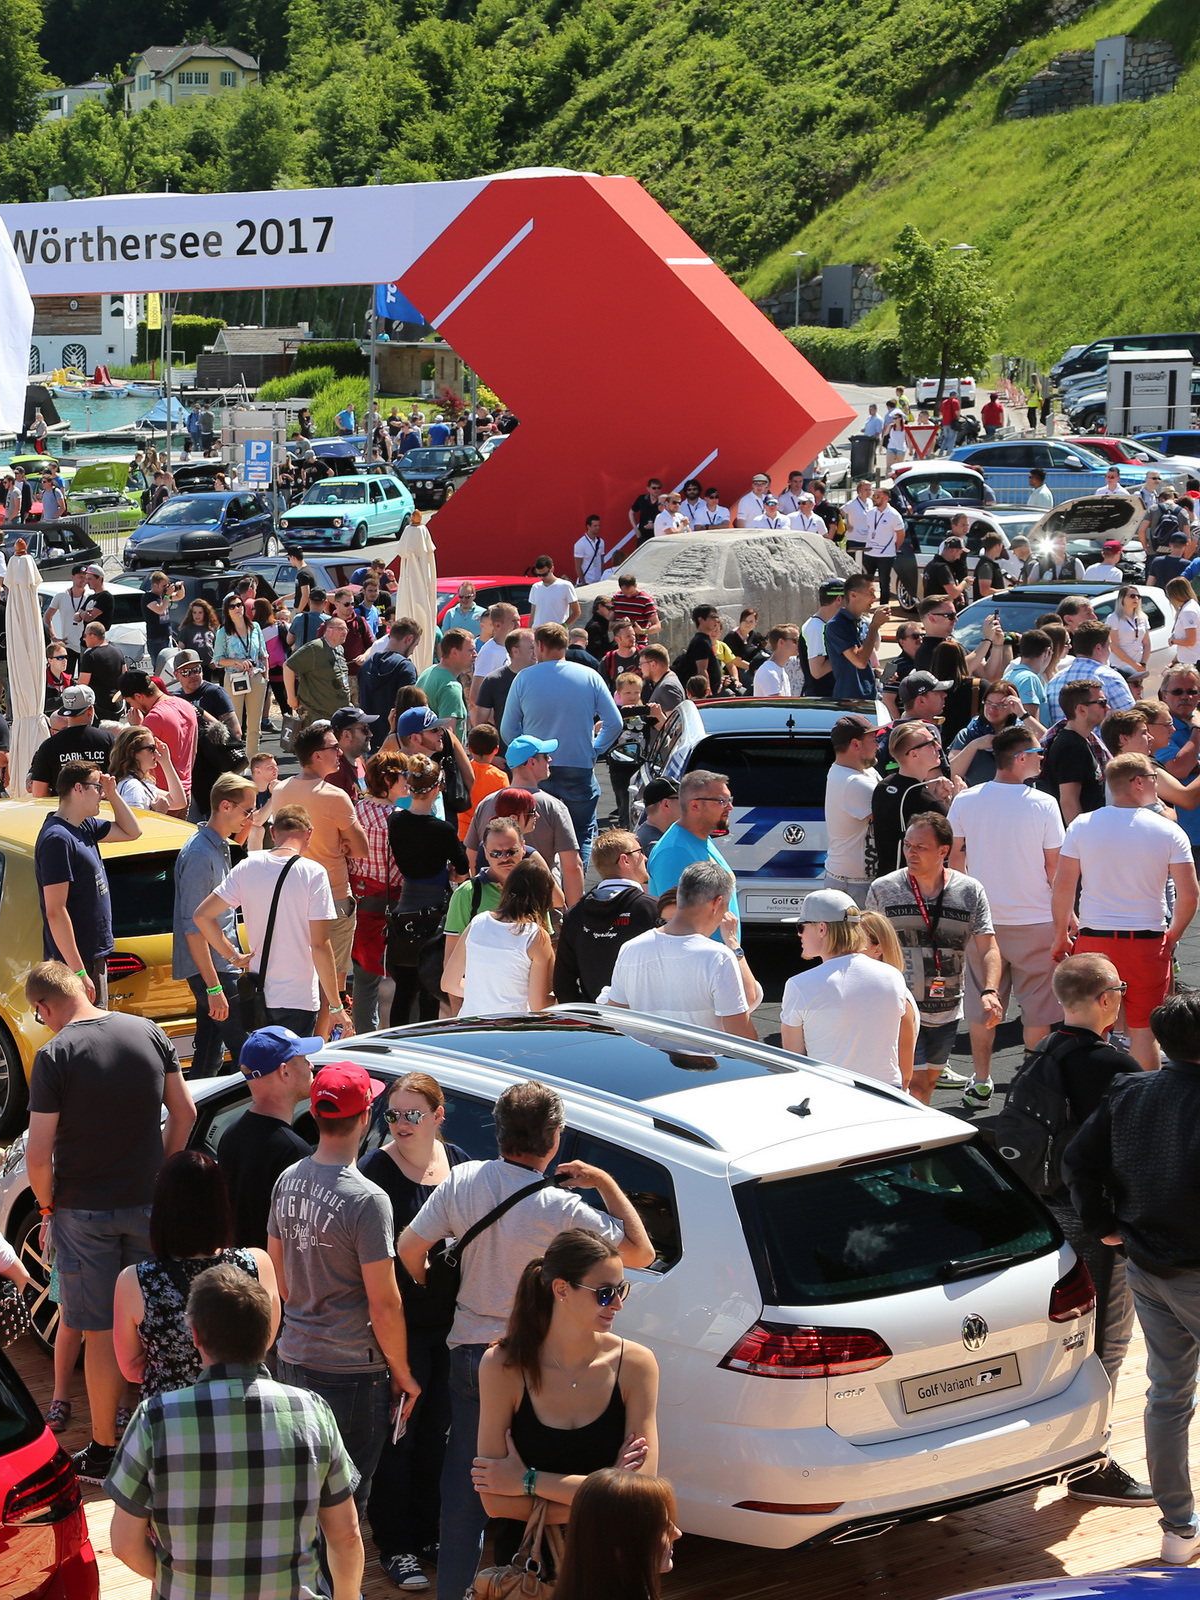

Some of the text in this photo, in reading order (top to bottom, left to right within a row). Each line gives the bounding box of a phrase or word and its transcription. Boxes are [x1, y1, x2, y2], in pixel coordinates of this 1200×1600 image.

[13, 225, 223, 264] Wörthersee
[236, 216, 334, 256] 2017
[251, 441, 267, 460] P
[310, 1182, 346, 1212] LEAGUE
[834, 1387, 866, 1400] GOLF
[917, 1385, 939, 1400] Golf
[940, 1376, 974, 1394] Variant
